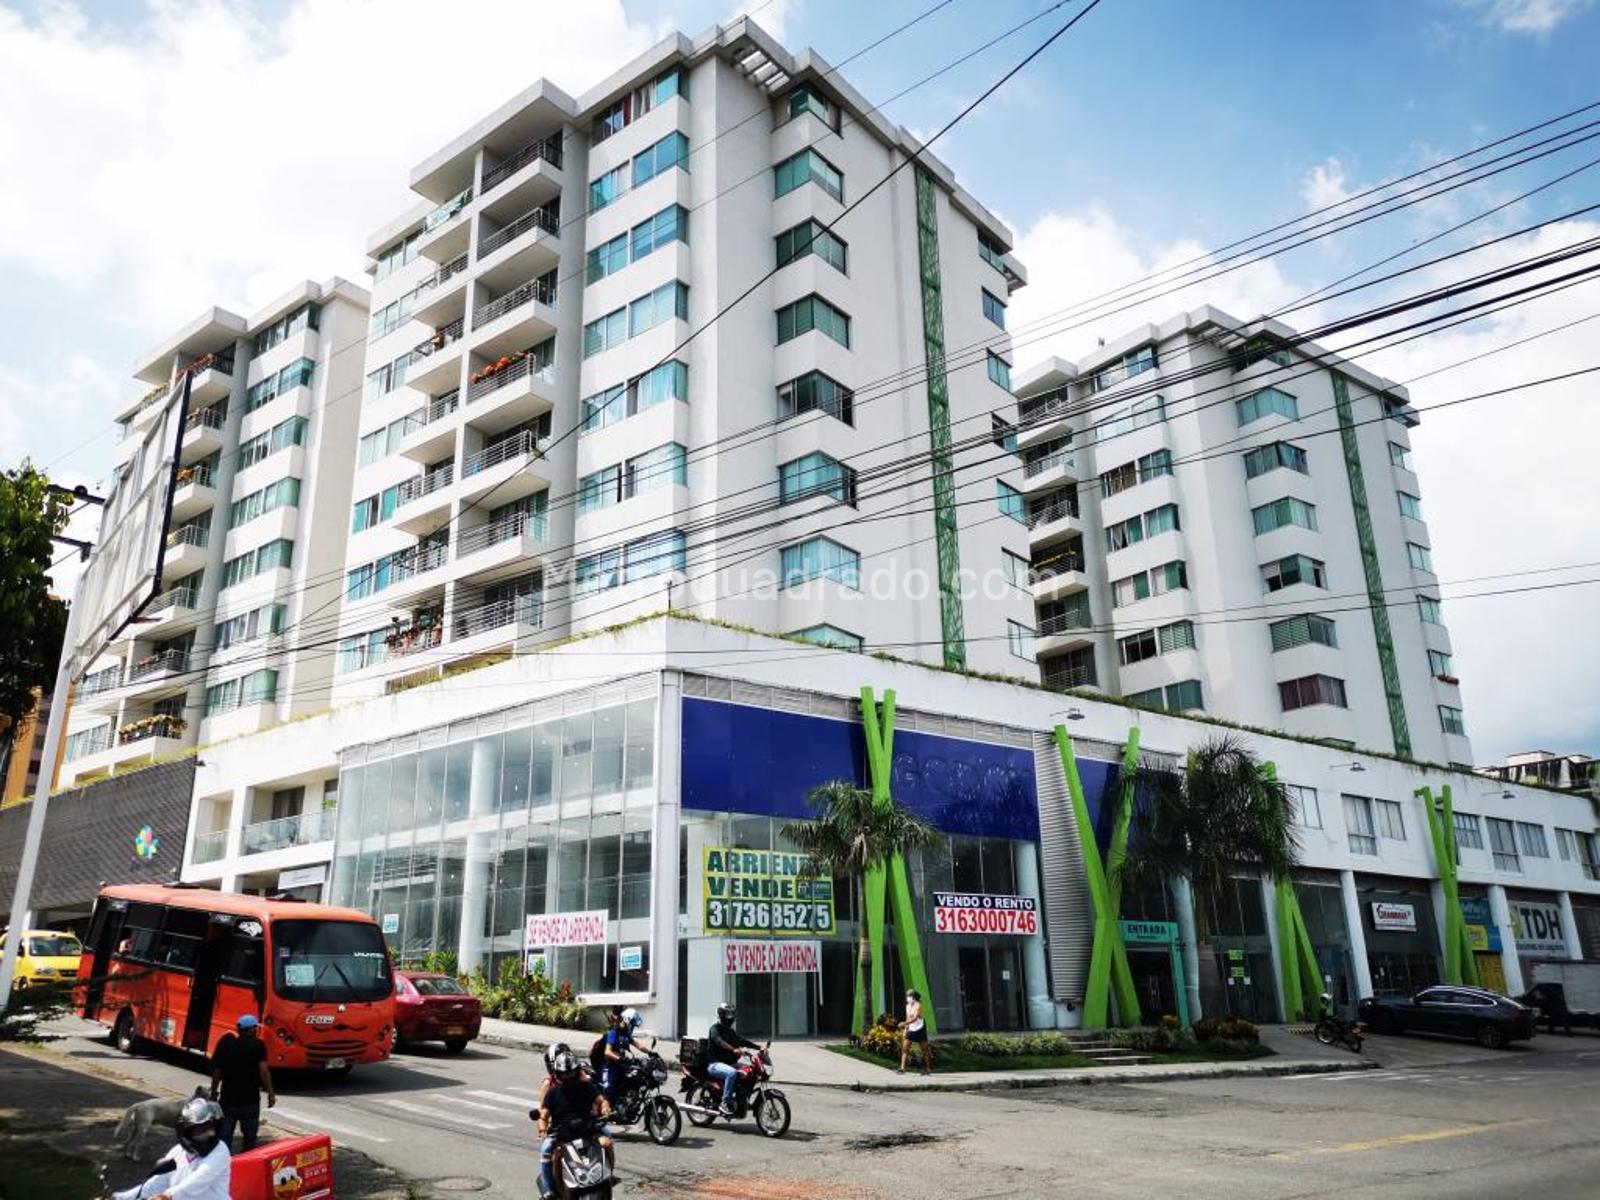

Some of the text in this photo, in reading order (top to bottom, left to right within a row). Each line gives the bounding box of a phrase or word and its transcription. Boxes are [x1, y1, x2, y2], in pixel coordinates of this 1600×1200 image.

[707, 876, 795, 899] VENDE
[708, 900, 830, 929] 3173685275
[937, 894, 1033, 910] VENDO O RENTO
[539, 917, 561, 944] VENDE
[569, 915, 604, 942] ARRIENDA
[936, 908, 1036, 934] 3163000746
[1127, 924, 1168, 935] ENTRADA
[1519, 907, 1564, 940] TDH
[726, 943, 818, 972] SE VENDE O ARRIENDA
